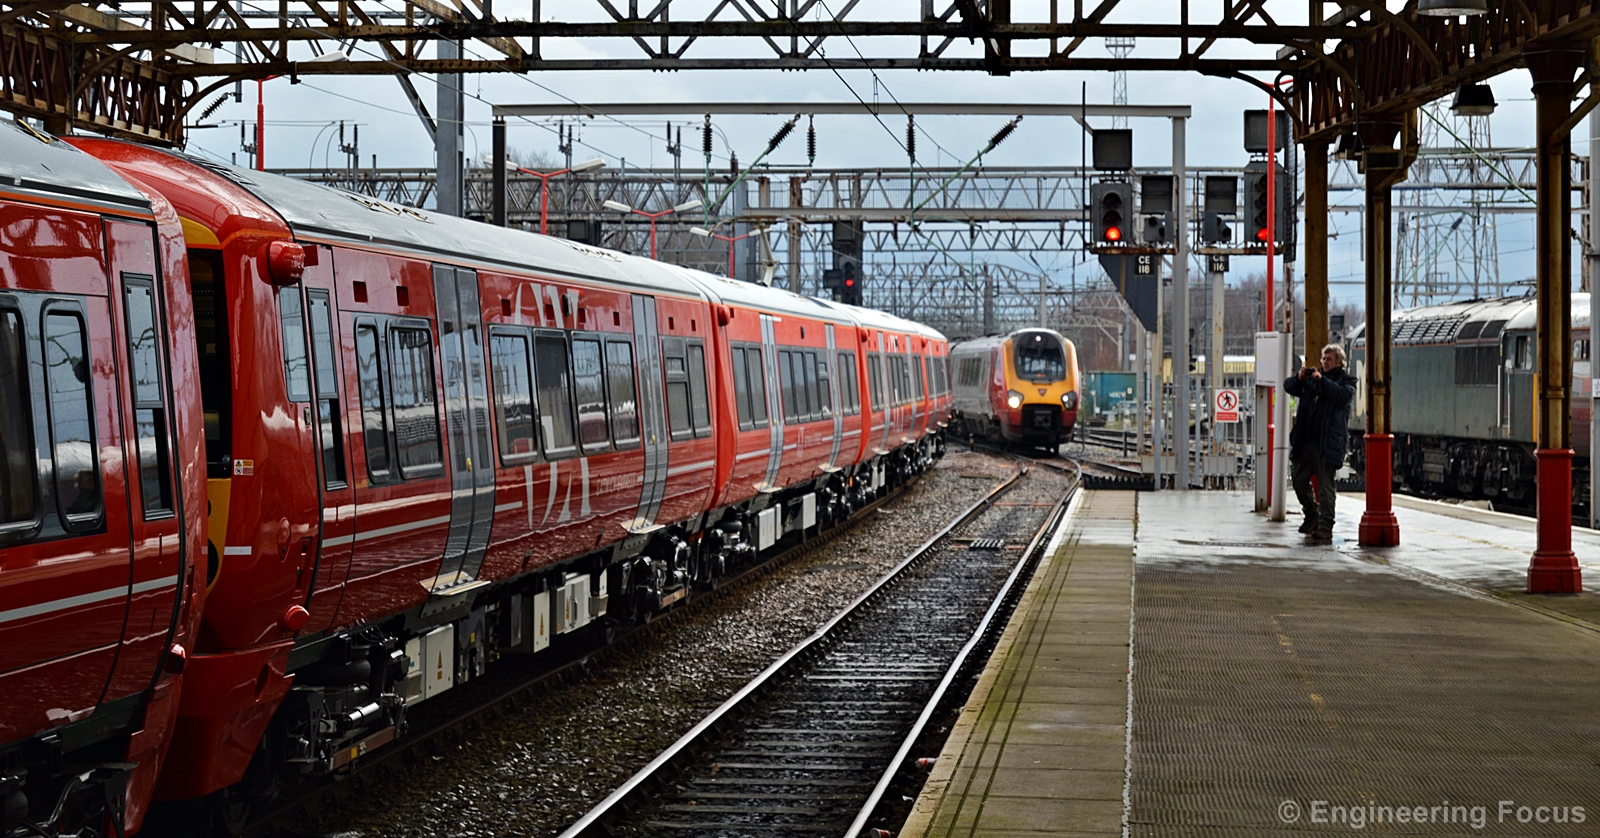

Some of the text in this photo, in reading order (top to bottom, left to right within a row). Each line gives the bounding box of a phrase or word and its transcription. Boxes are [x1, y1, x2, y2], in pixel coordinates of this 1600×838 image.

[1138, 256, 1150, 264] CE
[1138, 265, 1150, 274] 118
[1213, 263, 1225, 271] 116
